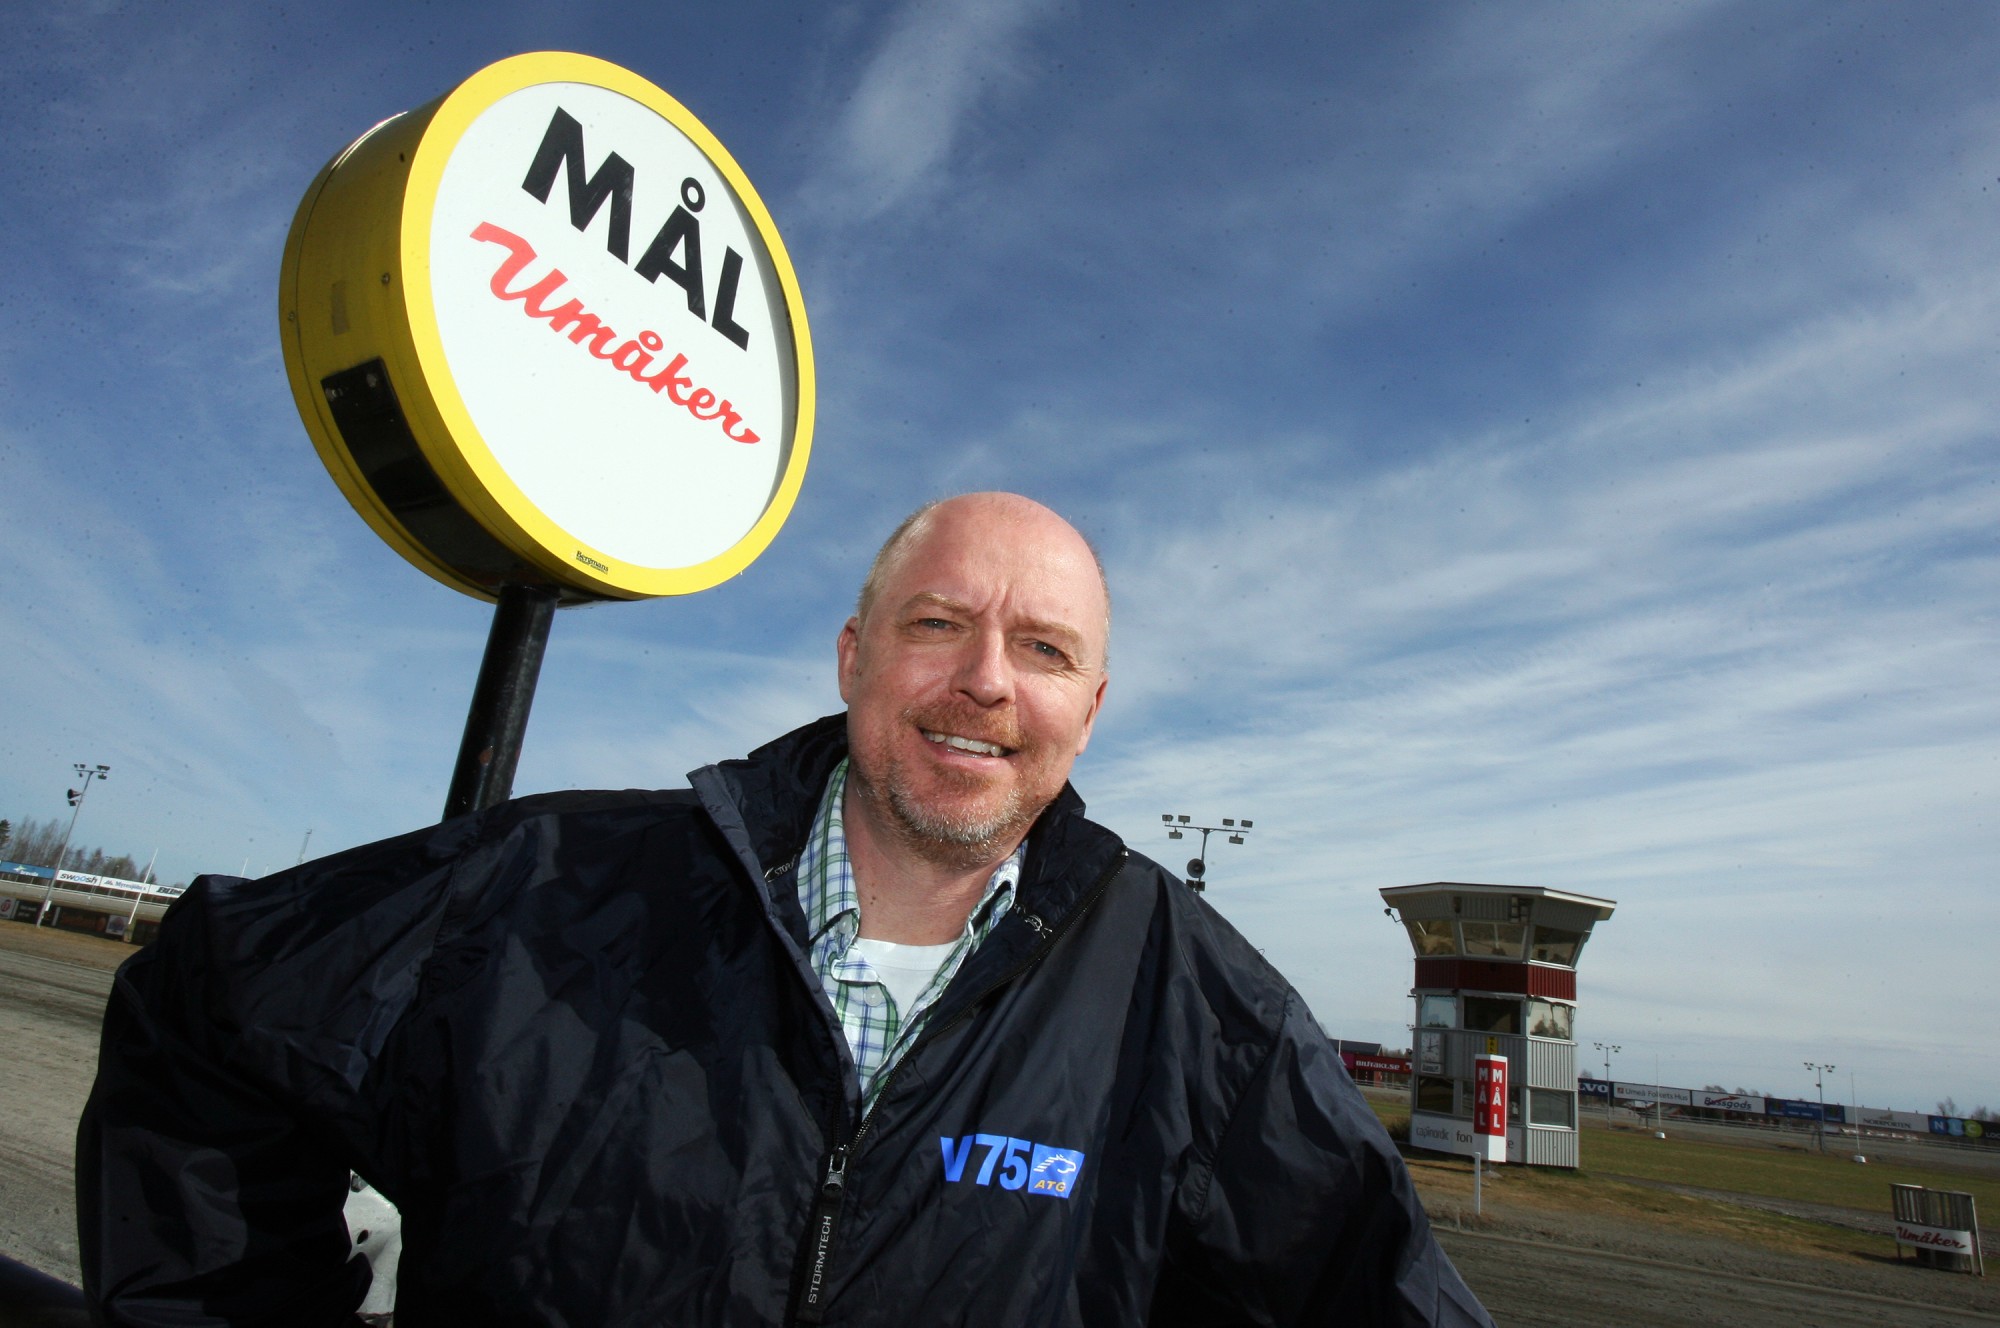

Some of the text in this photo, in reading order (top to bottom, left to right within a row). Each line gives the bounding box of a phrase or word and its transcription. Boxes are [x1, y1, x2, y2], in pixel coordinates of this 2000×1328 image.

[522, 106, 749, 352] MÅL
[470, 221, 760, 445] Umåker
[576, 550, 609, 572] Bergmans
[60, 873, 98, 884] swoosh
[1478, 1067, 1489, 1127] MÅL
[1492, 1068, 1503, 1129] MÅL
[940, 1133, 1031, 1190] V75
[1034, 1179, 1067, 1192] ATG
[808, 1215, 832, 1304] STORMTECH
[1896, 1226, 1967, 1249] Umåker
